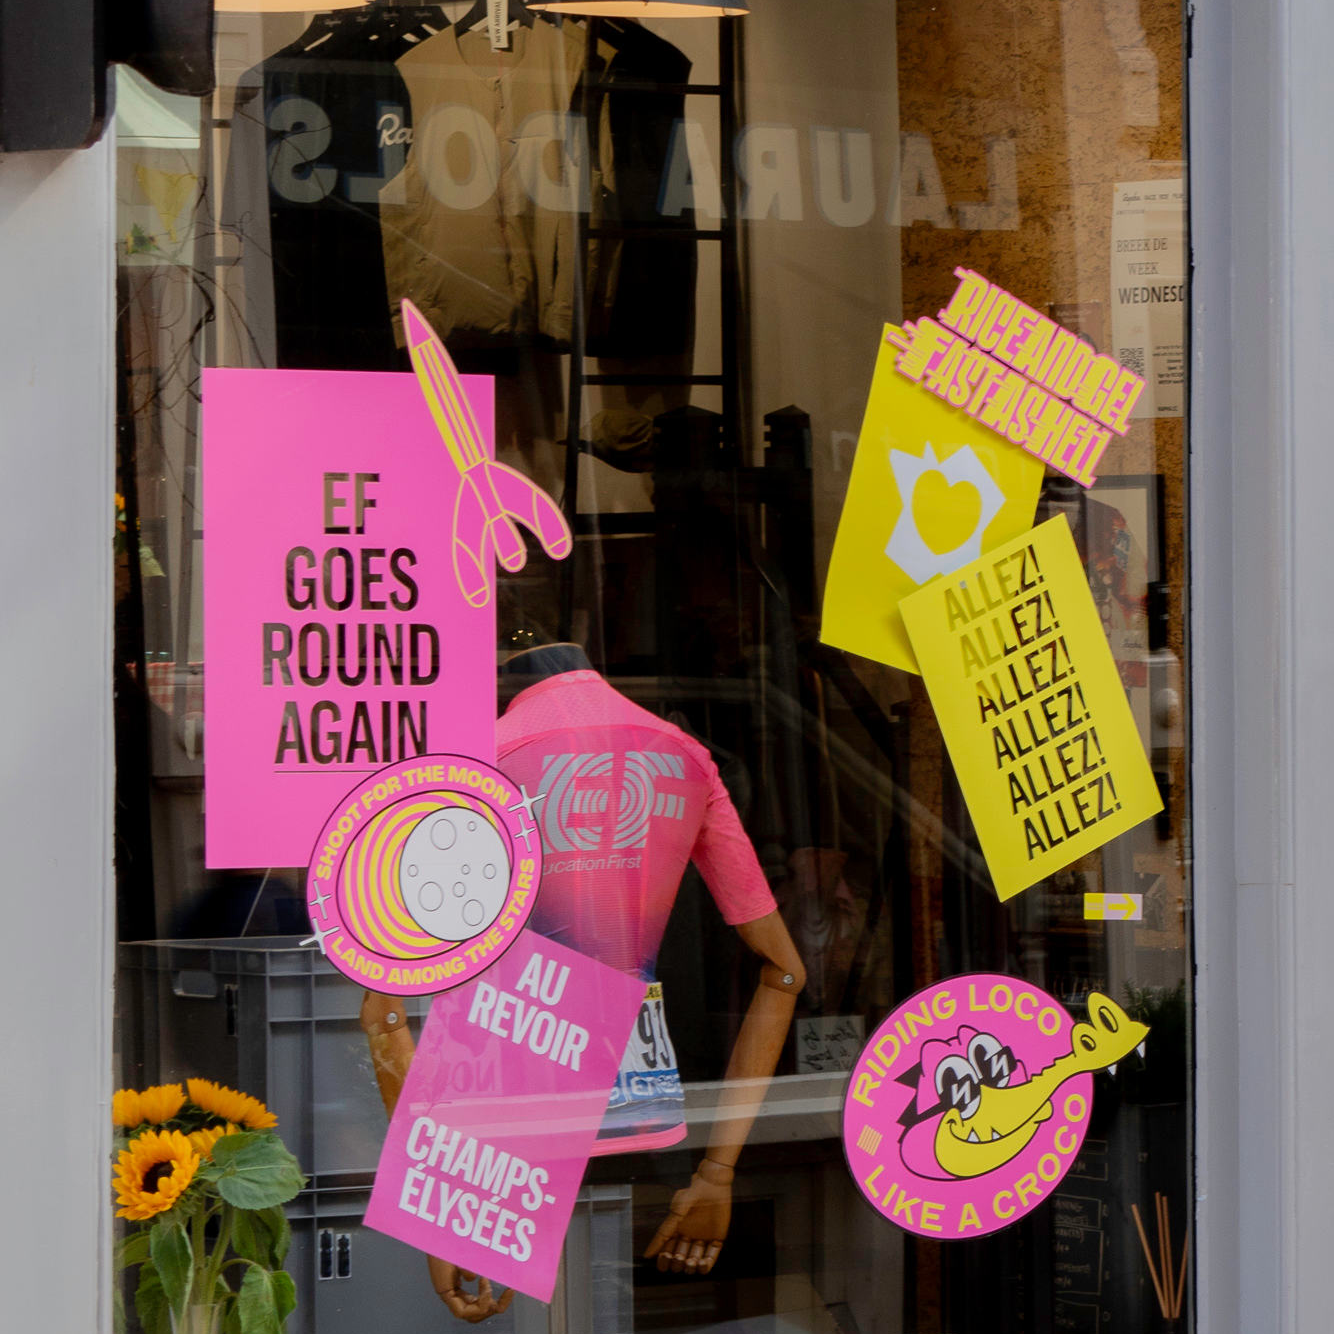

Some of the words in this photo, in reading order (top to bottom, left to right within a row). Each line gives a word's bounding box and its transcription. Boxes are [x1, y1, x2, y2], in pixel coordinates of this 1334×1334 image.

[1128, 261, 1160, 277] WEEK
[1153, 237, 1168, 252] DE
[322, 471, 381, 536] EF
[284, 546, 420, 612] GOES
[944, 544, 1046, 632] ALLEZ!
[262, 622, 441, 687] ROUND
[960, 589, 1061, 678] ALLEZ!
[975, 636, 1076, 724] ALLEZ!
[274, 700, 430, 765] AGAIN
[992, 680, 1091, 770] ALLEZ!
[1007, 727, 1107, 816] ALLEZ!
[316, 804, 363, 880] SHOOT
[360, 775, 403, 810] FOR
[402, 765, 446, 787] THE
[447, 765, 512, 807] MOON
[1022, 771, 1123, 862] ALLEZ!
[607, 854, 642, 870] First
[331, 935, 384, 981] LAND
[386, 955, 467, 985] AMONG
[463, 927, 505, 964] THE
[500, 858, 536, 931] STARS
[515, 952, 571, 1006] AU
[467, 980, 591, 1072] REVOIR
[852, 990, 957, 1108] RIDING
[969, 983, 1062, 1036] LOCO
[405, 1117, 558, 1213] CHAMPS-
[864, 1165, 946, 1232] LIKE
[957, 1202, 983, 1232] A
[992, 1093, 1087, 1219] CROCO
[398, 1163, 537, 1263] ÉLYSÉES
